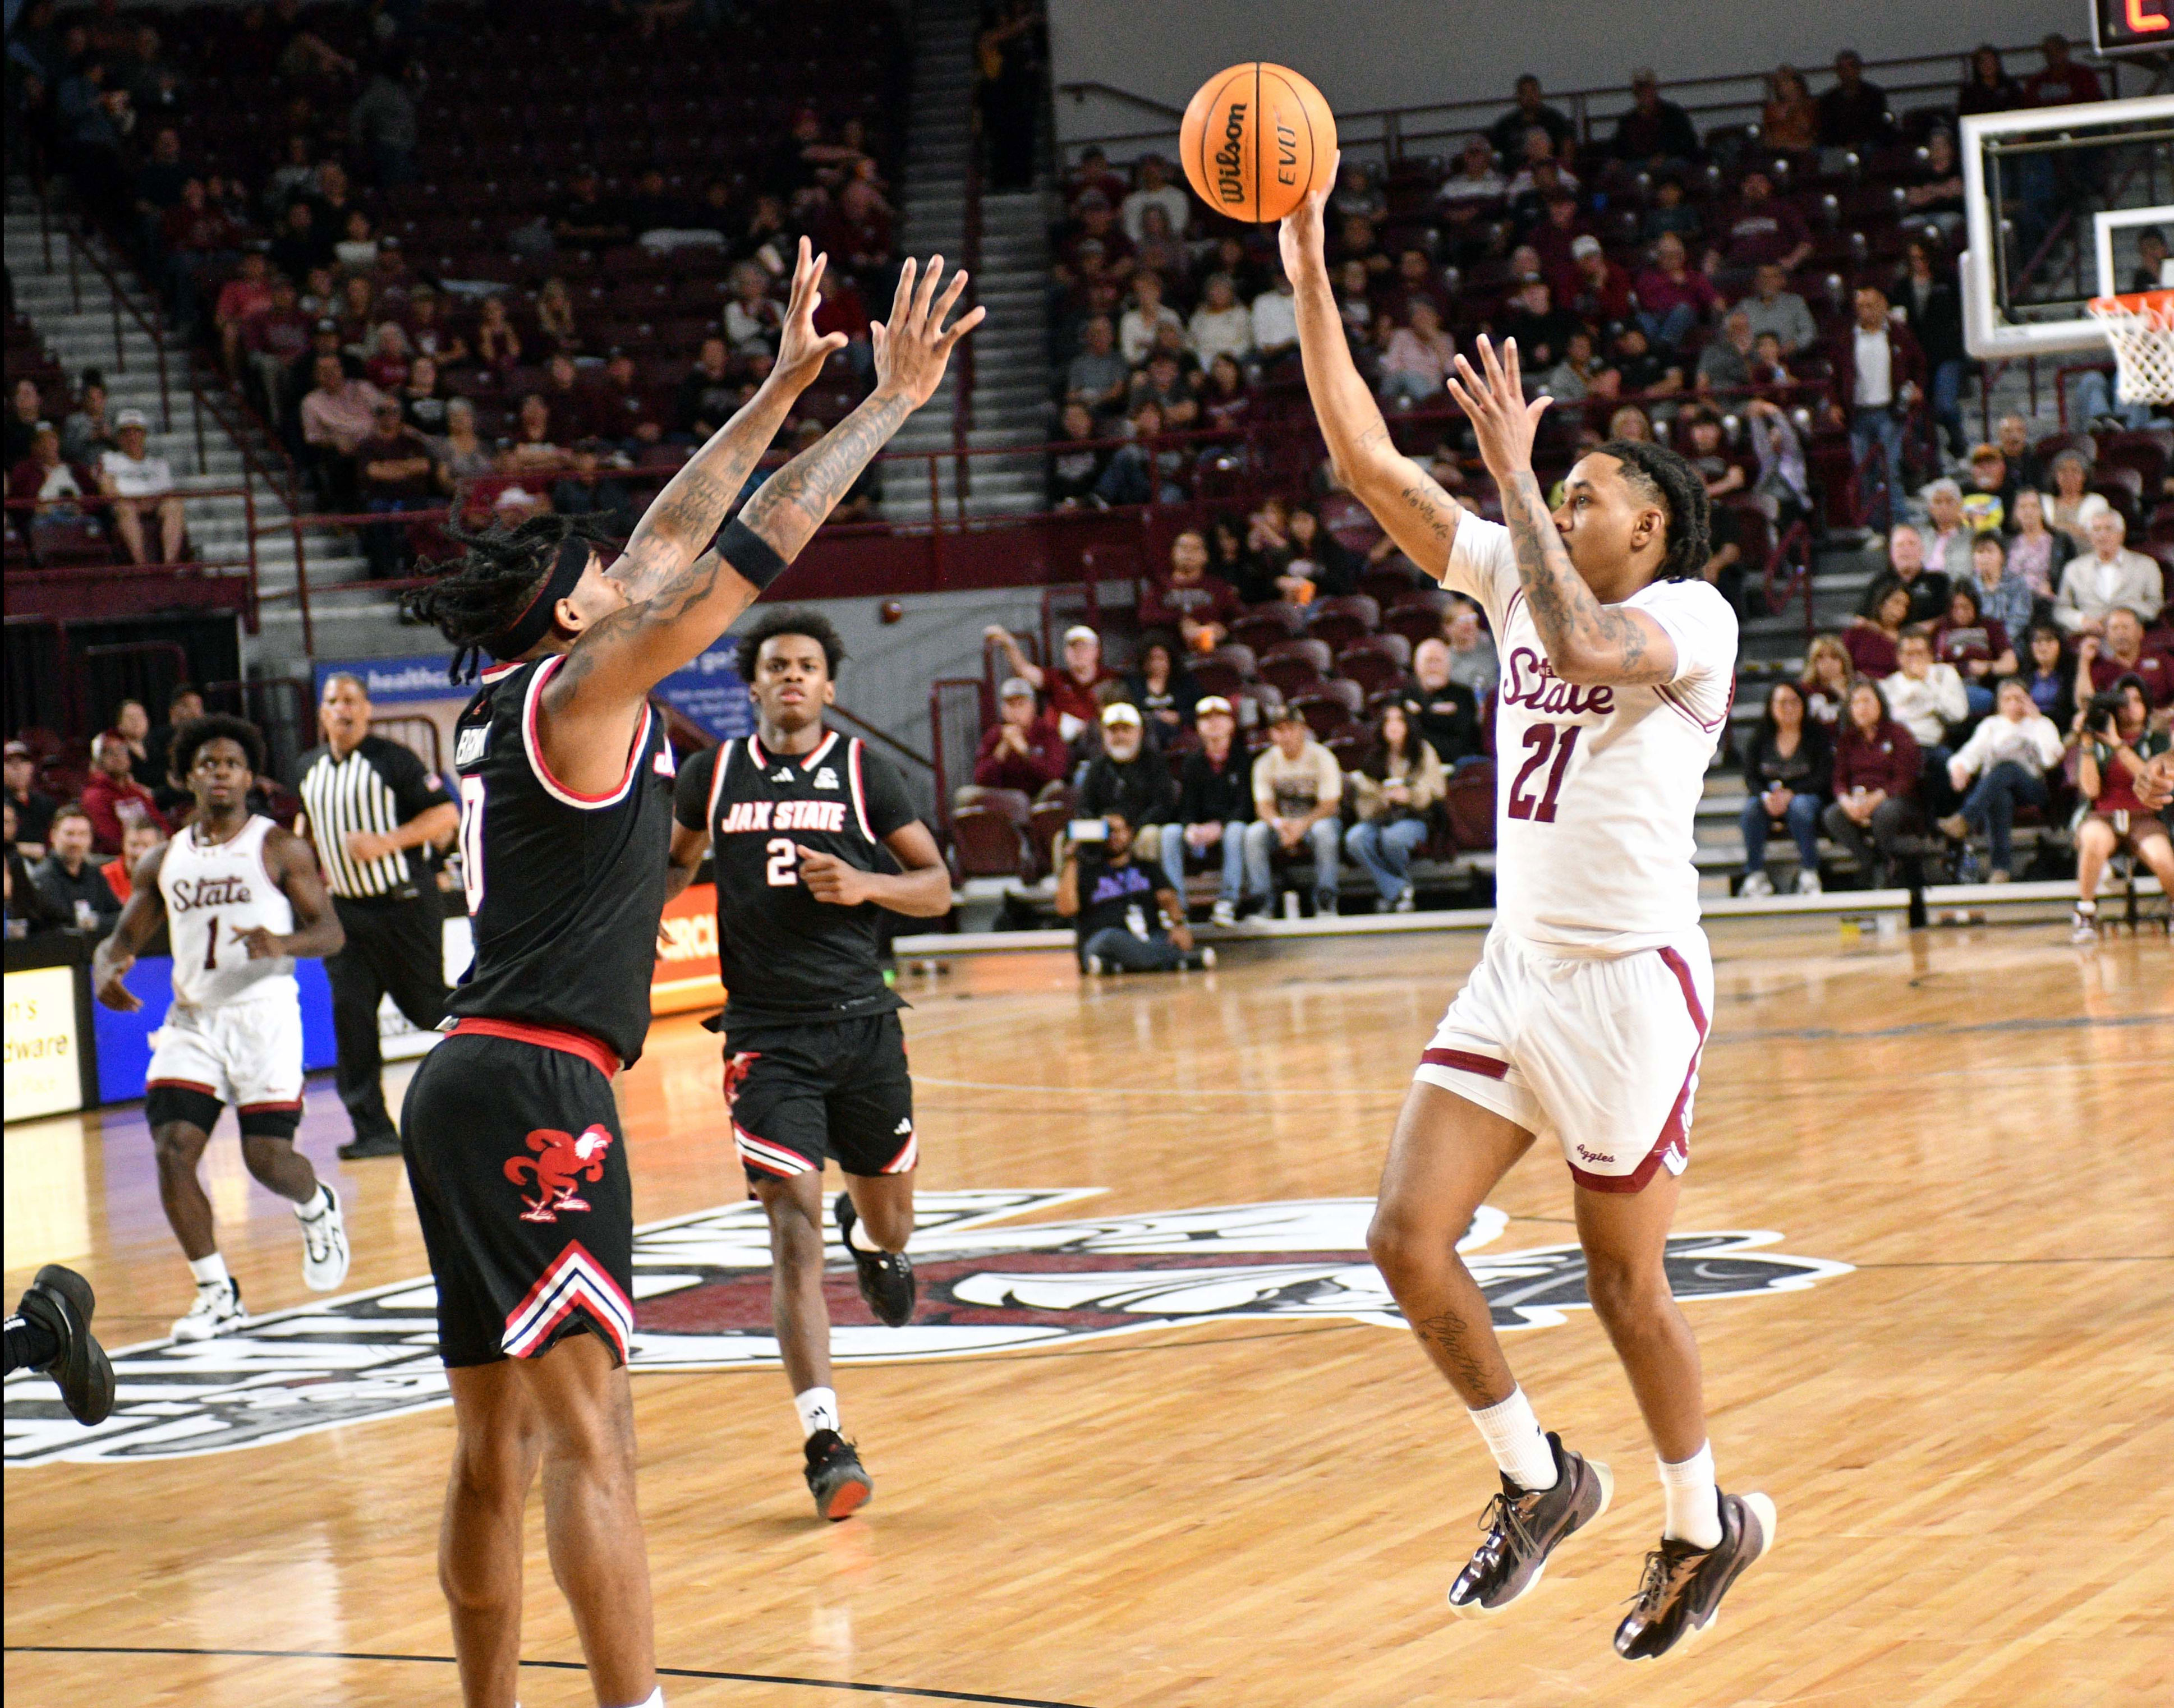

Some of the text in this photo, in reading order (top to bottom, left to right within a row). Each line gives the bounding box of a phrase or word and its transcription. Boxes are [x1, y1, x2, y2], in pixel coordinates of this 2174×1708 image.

[1215, 102, 1248, 204] Wilson
[1507, 722, 1583, 823] 21
[721, 799, 847, 834] JAX STATE
[765, 837, 798, 887] 2
[172, 875, 251, 913] State
[204, 914, 219, 970] 1
[1576, 1143, 1616, 1163] Aggies
